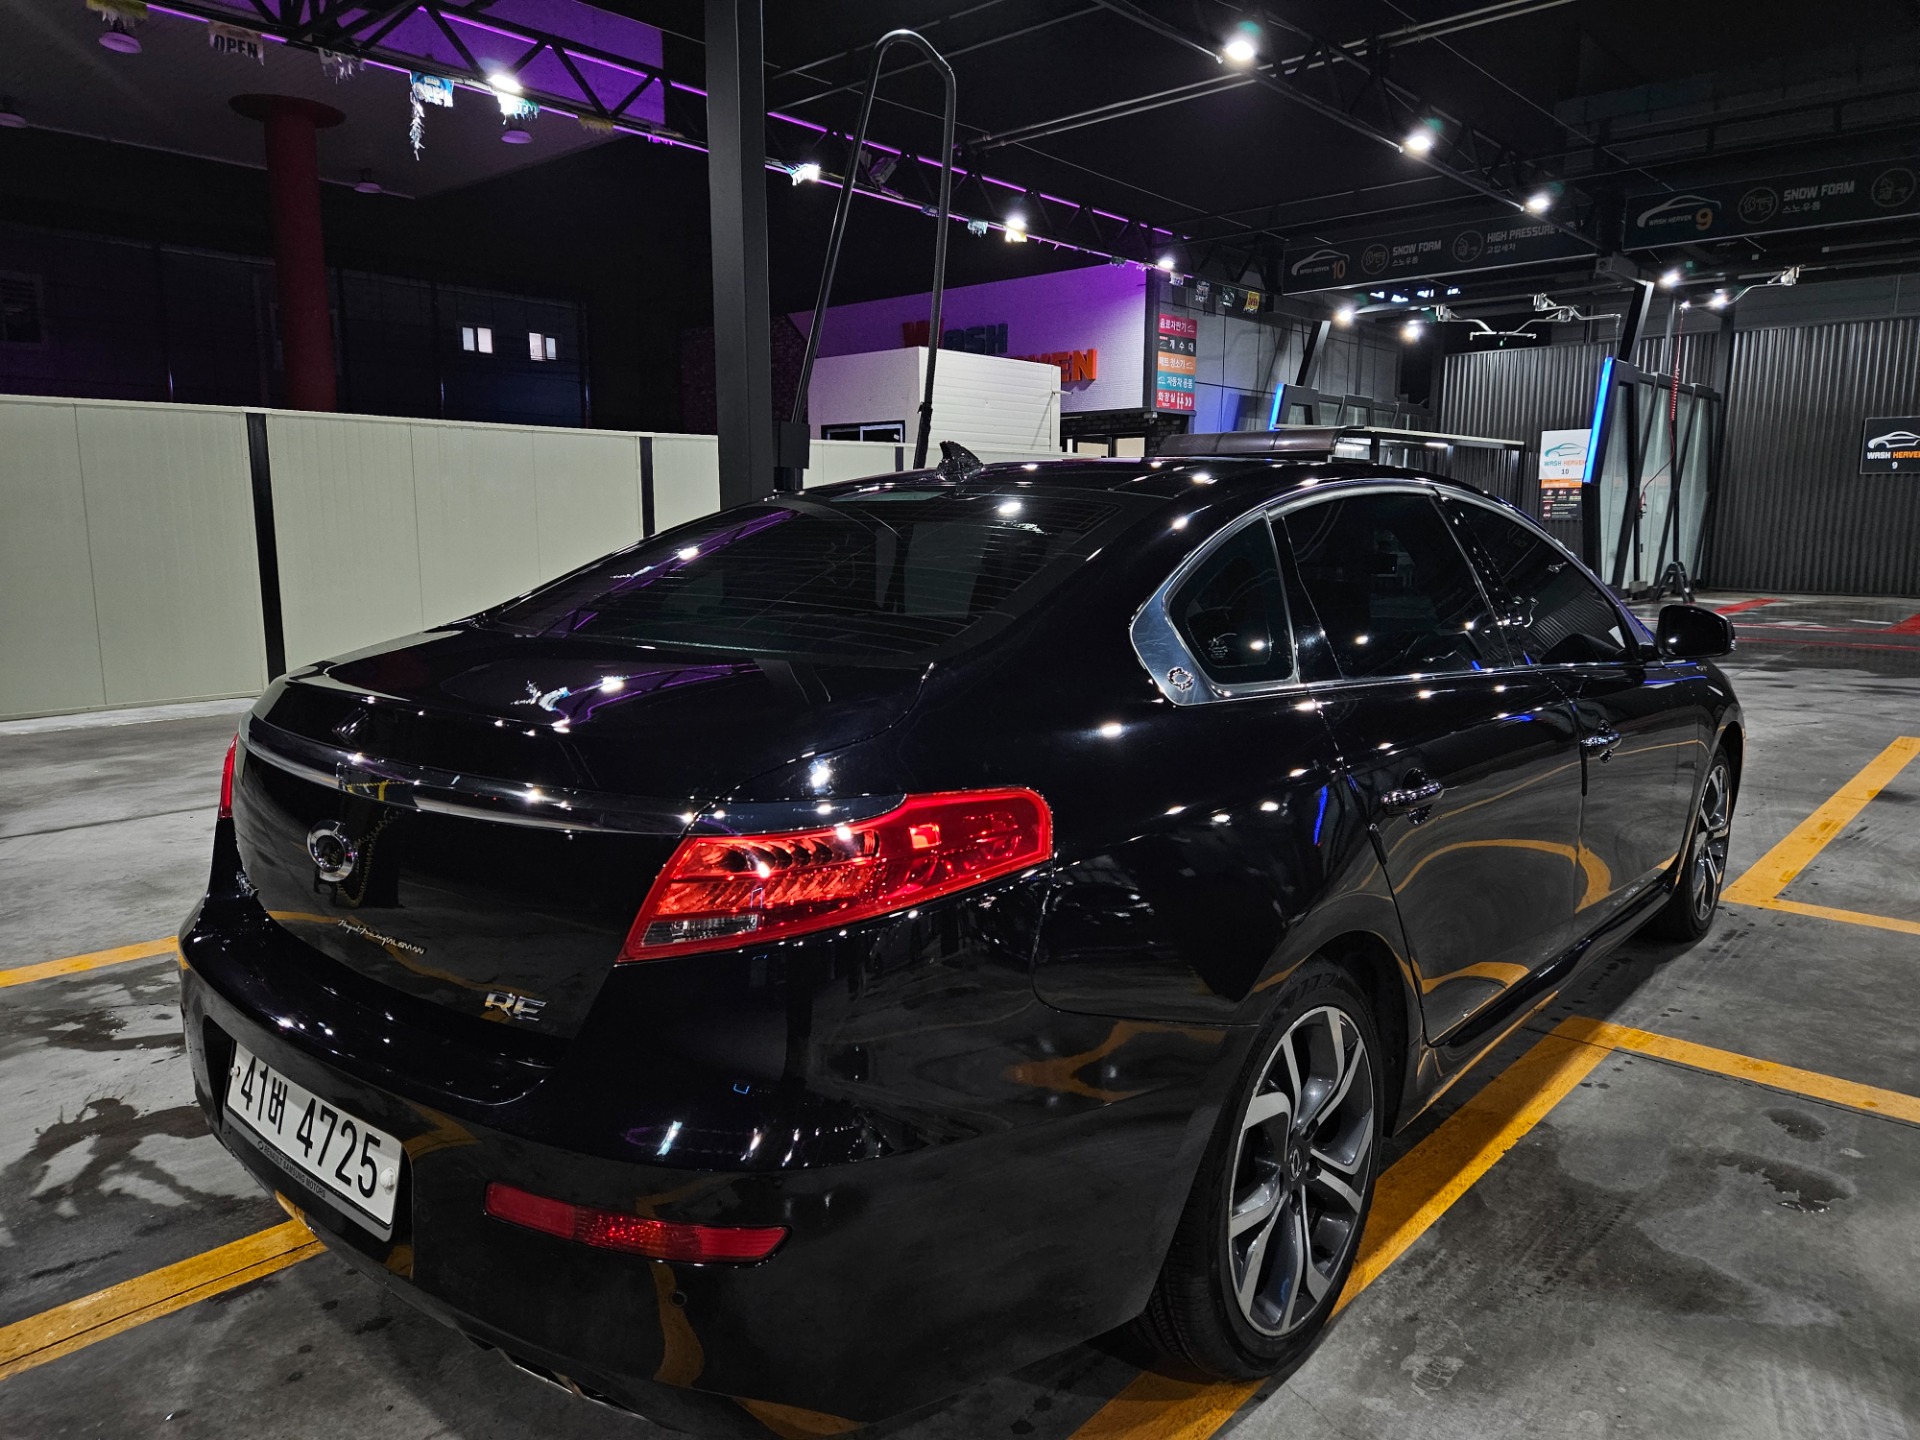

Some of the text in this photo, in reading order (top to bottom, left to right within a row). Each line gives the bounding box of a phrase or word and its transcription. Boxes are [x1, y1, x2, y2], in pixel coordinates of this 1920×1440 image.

[214, 34, 258, 58] OPEN
[1783, 186, 1818, 202] SNOW
[1695, 207, 1713, 231] 9
[1487, 230, 1507, 243] HIGH
[1509, 224, 1555, 240] PRESSURE
[1392, 243, 1417, 257] SNOW
[1331, 259, 1345, 279] 10
[1160, 318, 1187, 333] 음료자판기
[1867, 450, 1920, 460] WASH HEAVE
[1891, 461, 1898, 470] 9
[484, 991, 549, 1021] RE
[241, 1056, 381, 1198] 41버 4725
[306, 1176, 327, 1199] MOTORS
